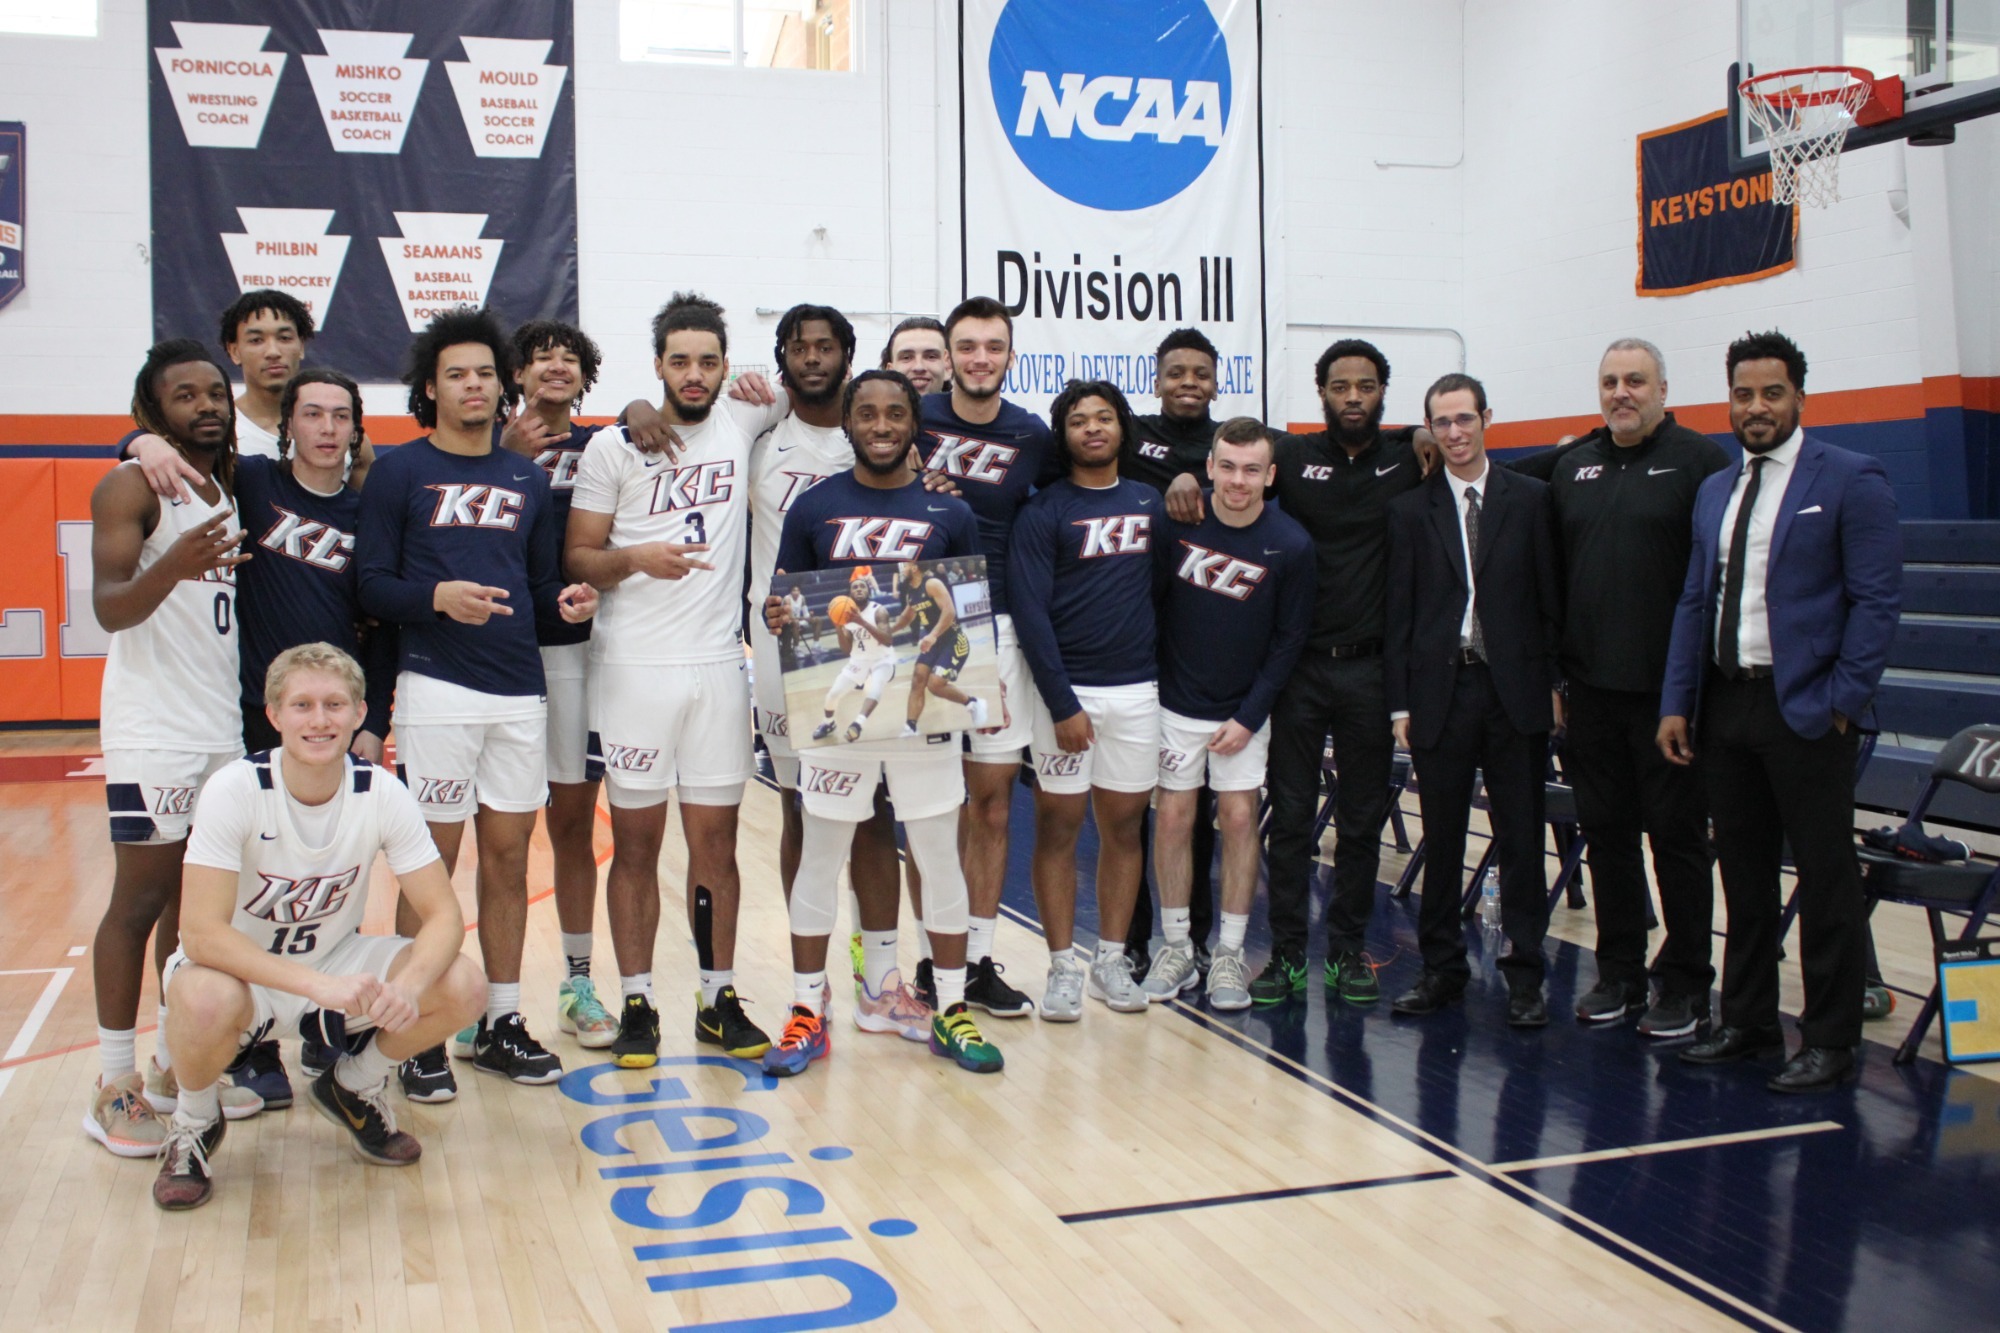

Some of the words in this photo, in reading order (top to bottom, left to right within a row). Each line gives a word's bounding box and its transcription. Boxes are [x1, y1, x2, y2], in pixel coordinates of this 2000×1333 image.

[171, 58, 273, 76] FORNICOLA
[335, 64, 402, 80] MISHKO
[479, 70, 538, 86] MOULD
[187, 93, 258, 107] WRESTLING
[339, 91, 392, 104] SOCCER
[480, 97, 538, 110] BASEBALL
[330, 109, 403, 123] BASKETBALL
[1015, 70, 1223, 147] NCAA
[197, 112, 249, 125] COACH
[483, 115, 535, 127] SOCCER
[342, 128, 392, 141] COACH
[485, 133, 534, 145] COACH
[255, 241, 318, 256] PHILBIN
[403, 244, 483, 260] SEAMANS
[242, 274, 275, 286] FIELD
[278, 275, 331, 287] HOCKEY
[414, 272, 473, 283] BASEBALL
[997, 249, 1183, 323] Division
[1200, 256, 1235, 323] III
[408, 290, 480, 301] BASKETBALL
[925, 429, 1020, 485] KC
[1138, 440, 1171, 461] KC
[1301, 463, 1334, 481] KC
[1574, 464, 1603, 482] KC
[647, 459, 735, 516] KC
[423, 483, 526, 532] KC
[257, 500, 356, 573] KC
[683, 511, 707, 545] 3
[1071, 513, 1152, 559] KC
[825, 516, 934, 562] KC
[1175, 538, 1269, 601] KC
[213, 591, 231, 635] 0
[607, 742, 659, 773] KC
[1037, 752, 1084, 776] KC
[418, 775, 470, 804] KC
[808, 766, 862, 797] KC
[243, 864, 361, 924] KC
[267, 922, 321, 955] 15
